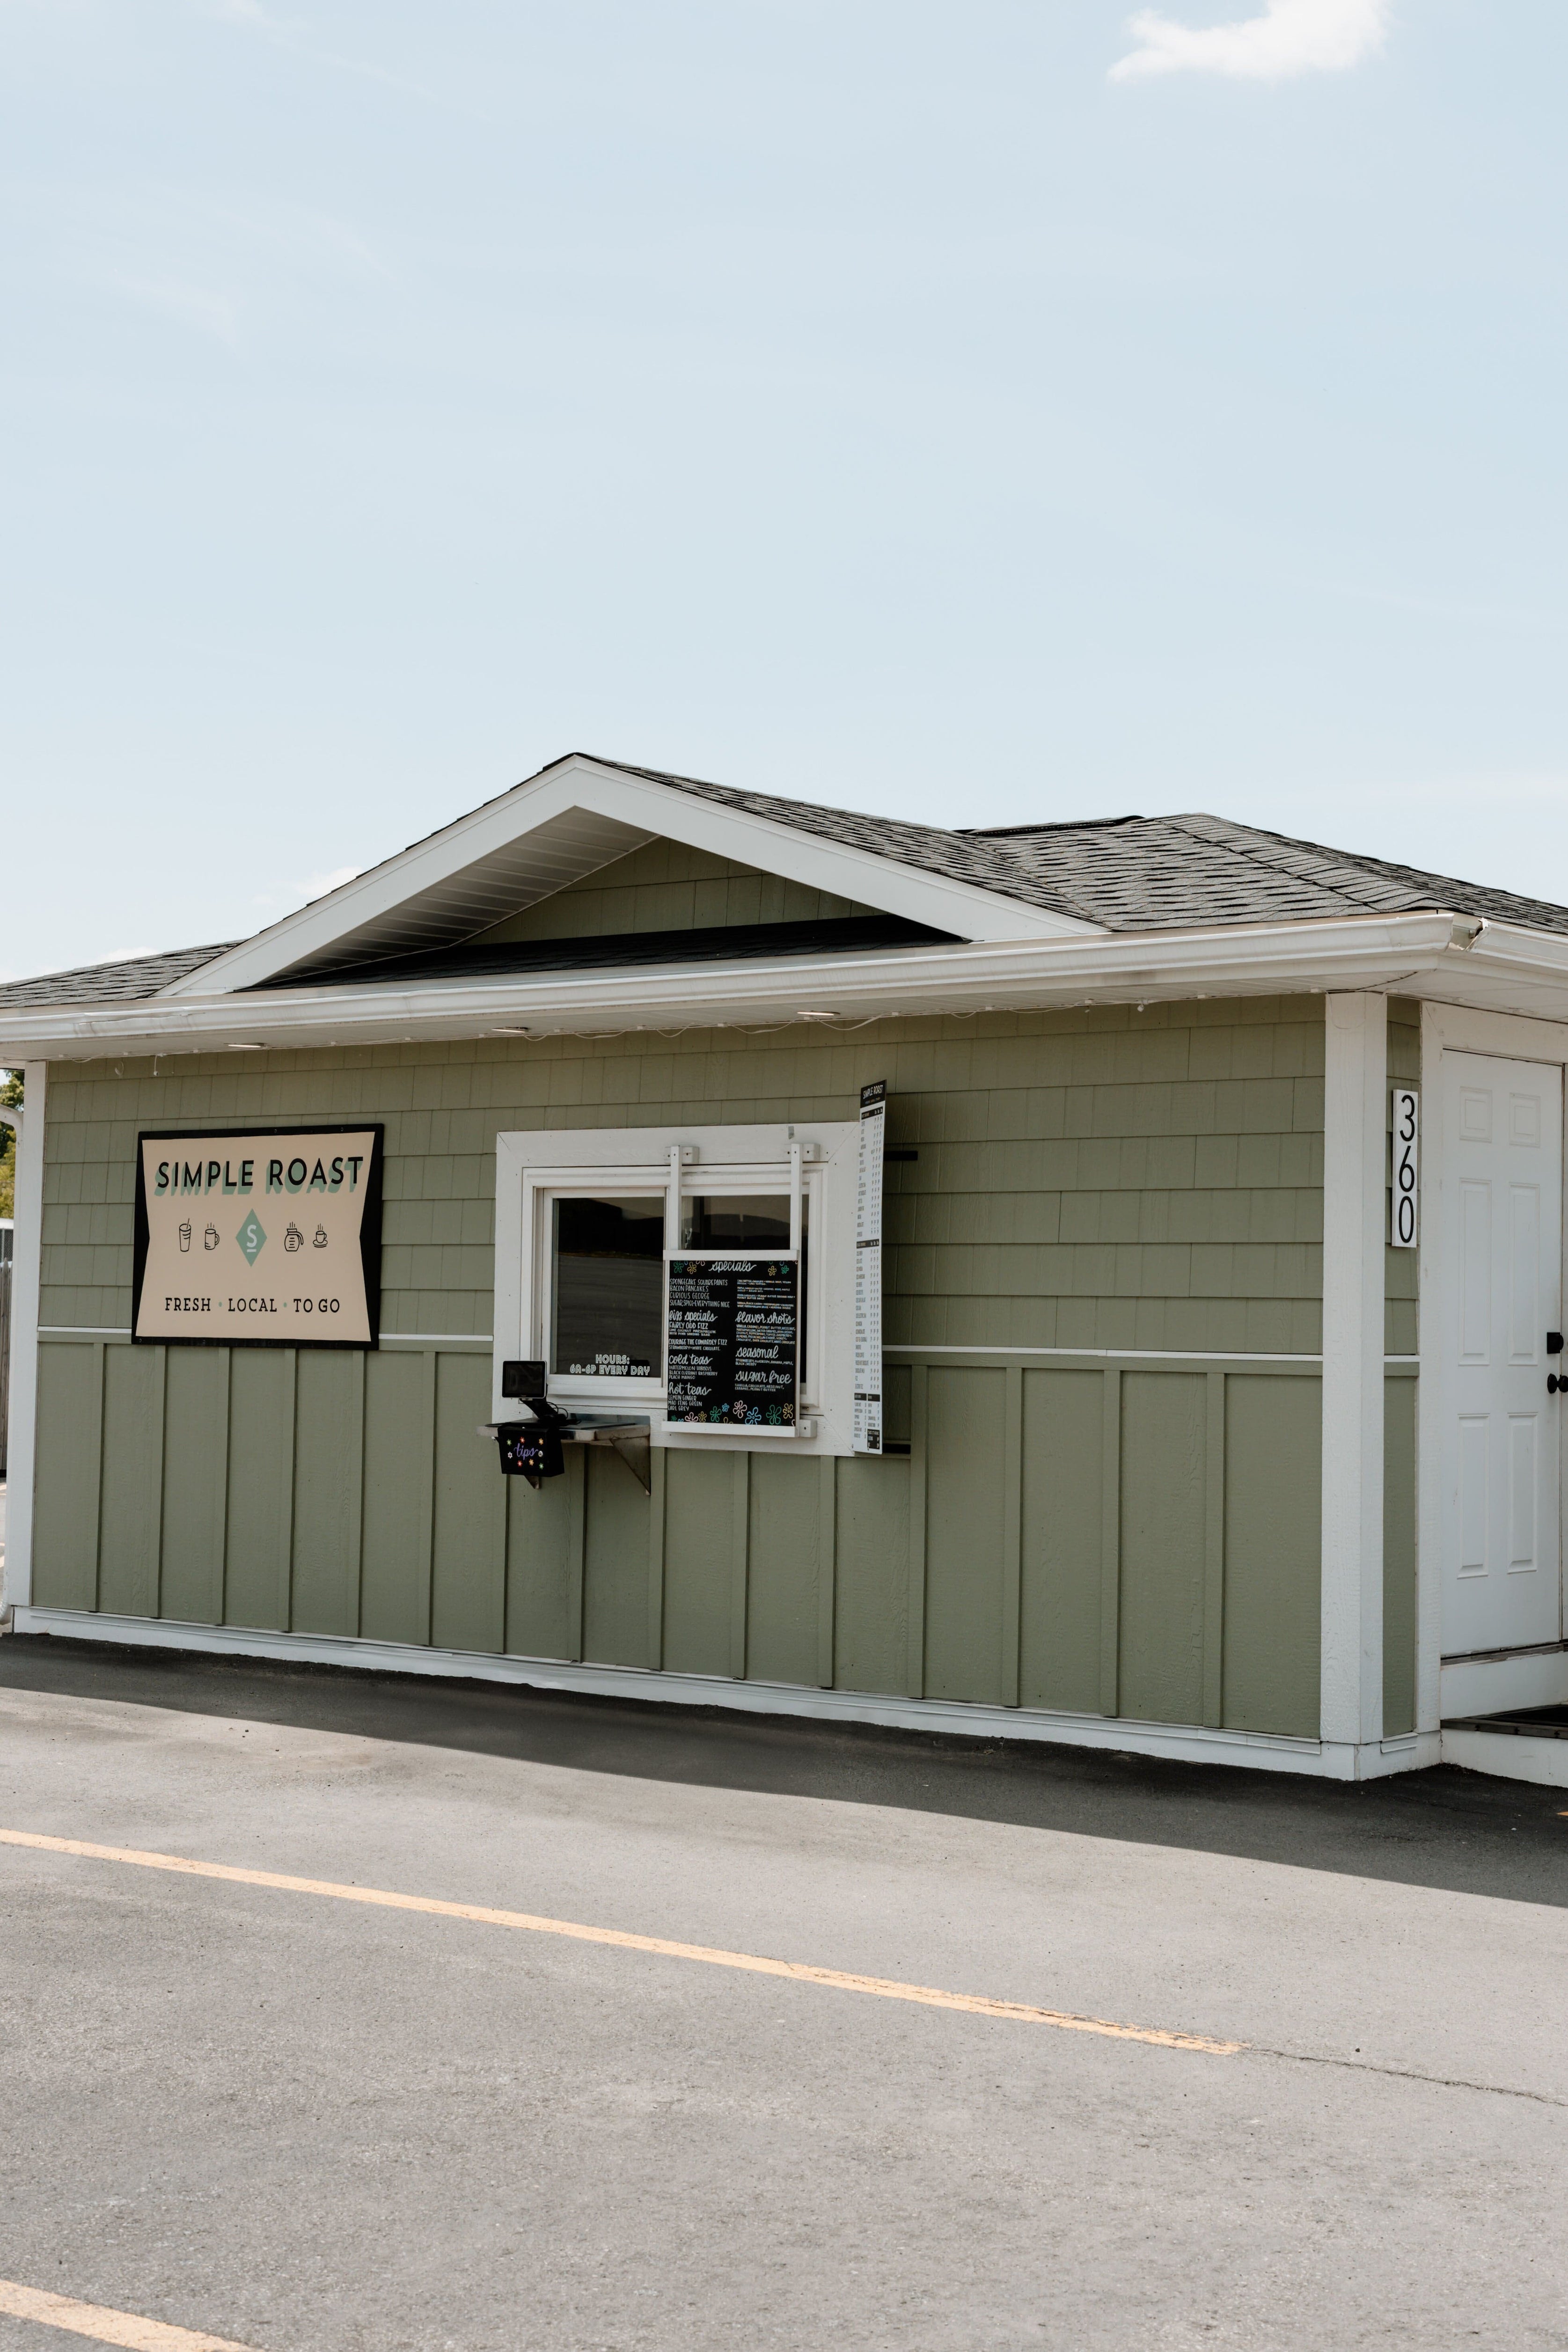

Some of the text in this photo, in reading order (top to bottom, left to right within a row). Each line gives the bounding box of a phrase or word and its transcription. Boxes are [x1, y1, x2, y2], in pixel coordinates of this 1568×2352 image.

[863, 1084, 883, 1099] SIMPLE ROAST
[157, 1156, 364, 1189] SIMPLE ROAST
[1399, 1094, 1415, 1243] 360
[247, 1224, 257, 1249] S
[708, 1260, 757, 1273] specials
[165, 1297, 340, 1313] FRESH LOCAL TO GO
[684, 1310, 718, 1323] specials
[735, 1311, 795, 1324] flavor shots
[735, 1345, 779, 1359] seasonal
[595, 1354, 630, 1365] HOURS:
[669, 1354, 713, 1365] cold teas
[570, 1363, 650, 1376] 6A-6P EVERY DAY
[734, 1370, 792, 1384] sugar free
[668, 1382, 712, 1395] hot teas
[513, 1443, 538, 1460] tips
